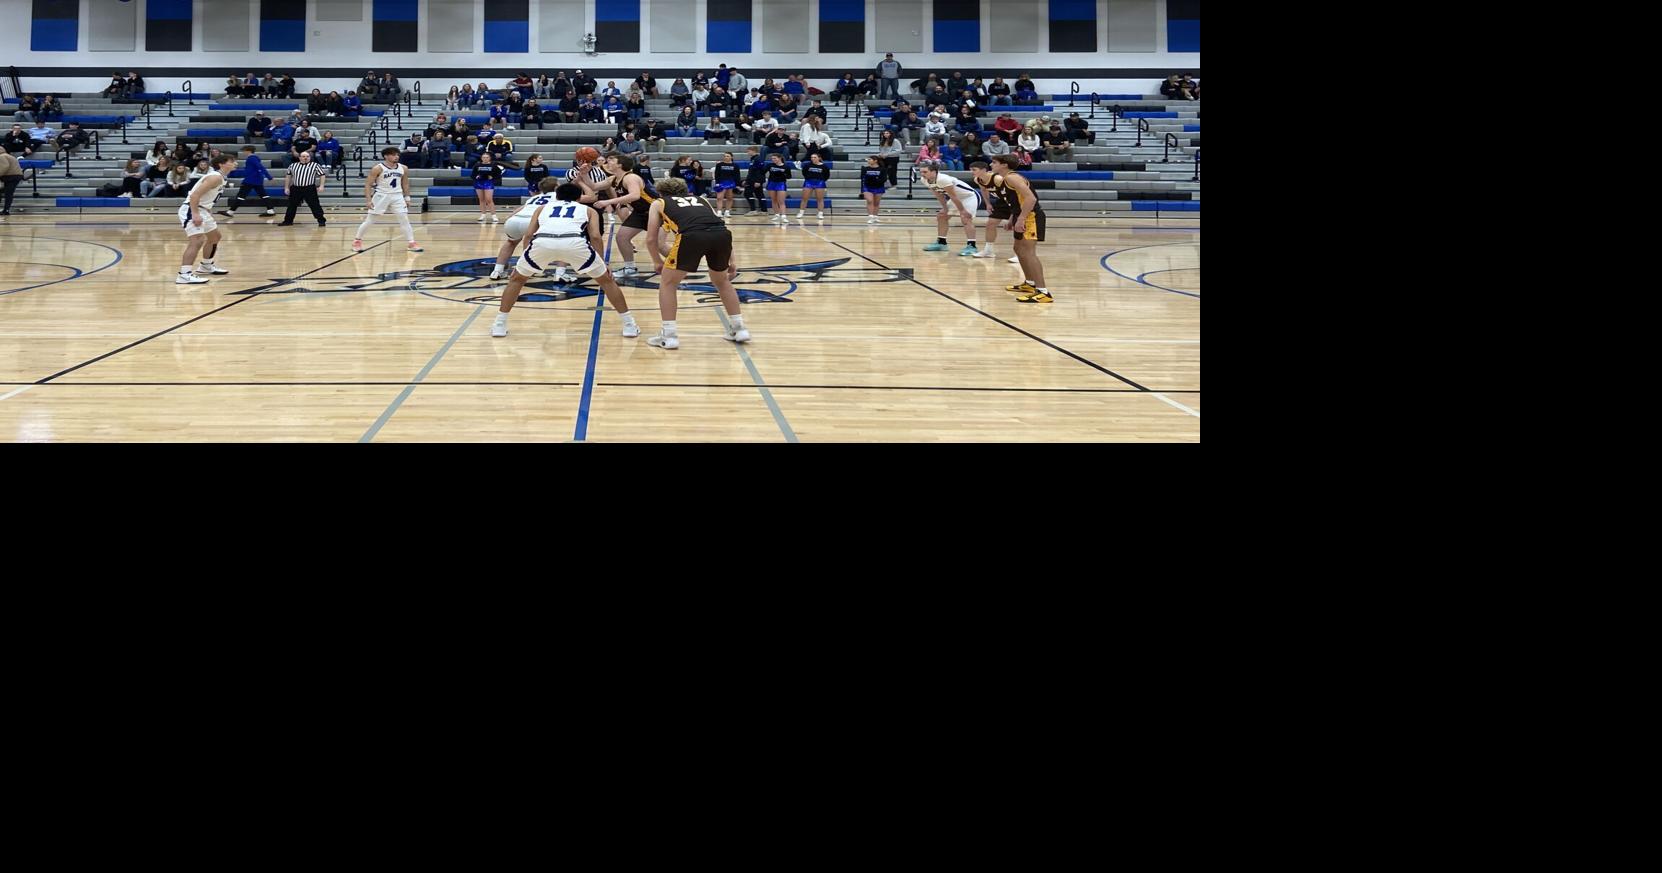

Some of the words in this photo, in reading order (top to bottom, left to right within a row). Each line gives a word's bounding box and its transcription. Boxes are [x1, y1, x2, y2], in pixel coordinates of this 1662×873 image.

[390, 178, 397, 188] 4
[527, 195, 551, 205] 15
[671, 196, 704, 207] 32
[549, 206, 576, 218] 11
